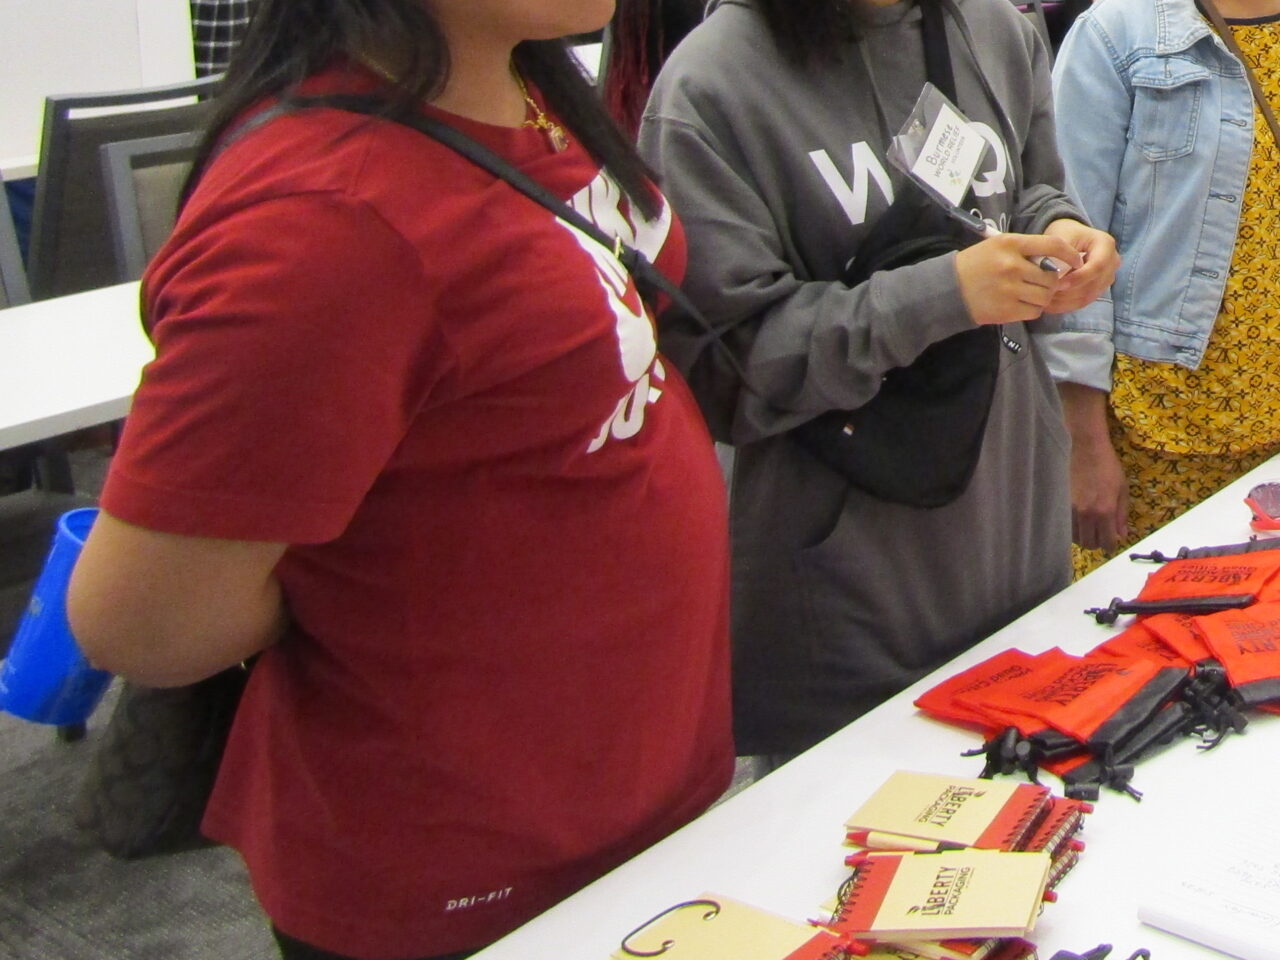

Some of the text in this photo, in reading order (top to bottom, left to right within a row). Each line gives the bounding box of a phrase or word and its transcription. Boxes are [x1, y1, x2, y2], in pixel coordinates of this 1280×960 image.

[926, 124, 954, 166] Burmese
[934, 150, 951, 178] WORLD
[918, 785, 956, 823] PACKAGING
[930, 786, 976, 827] LIBERTY
[446, 887, 512, 910] DRI-FIT
[921, 867, 958, 916] LIBERTY
[944, 867, 970, 915] PACKAGING
